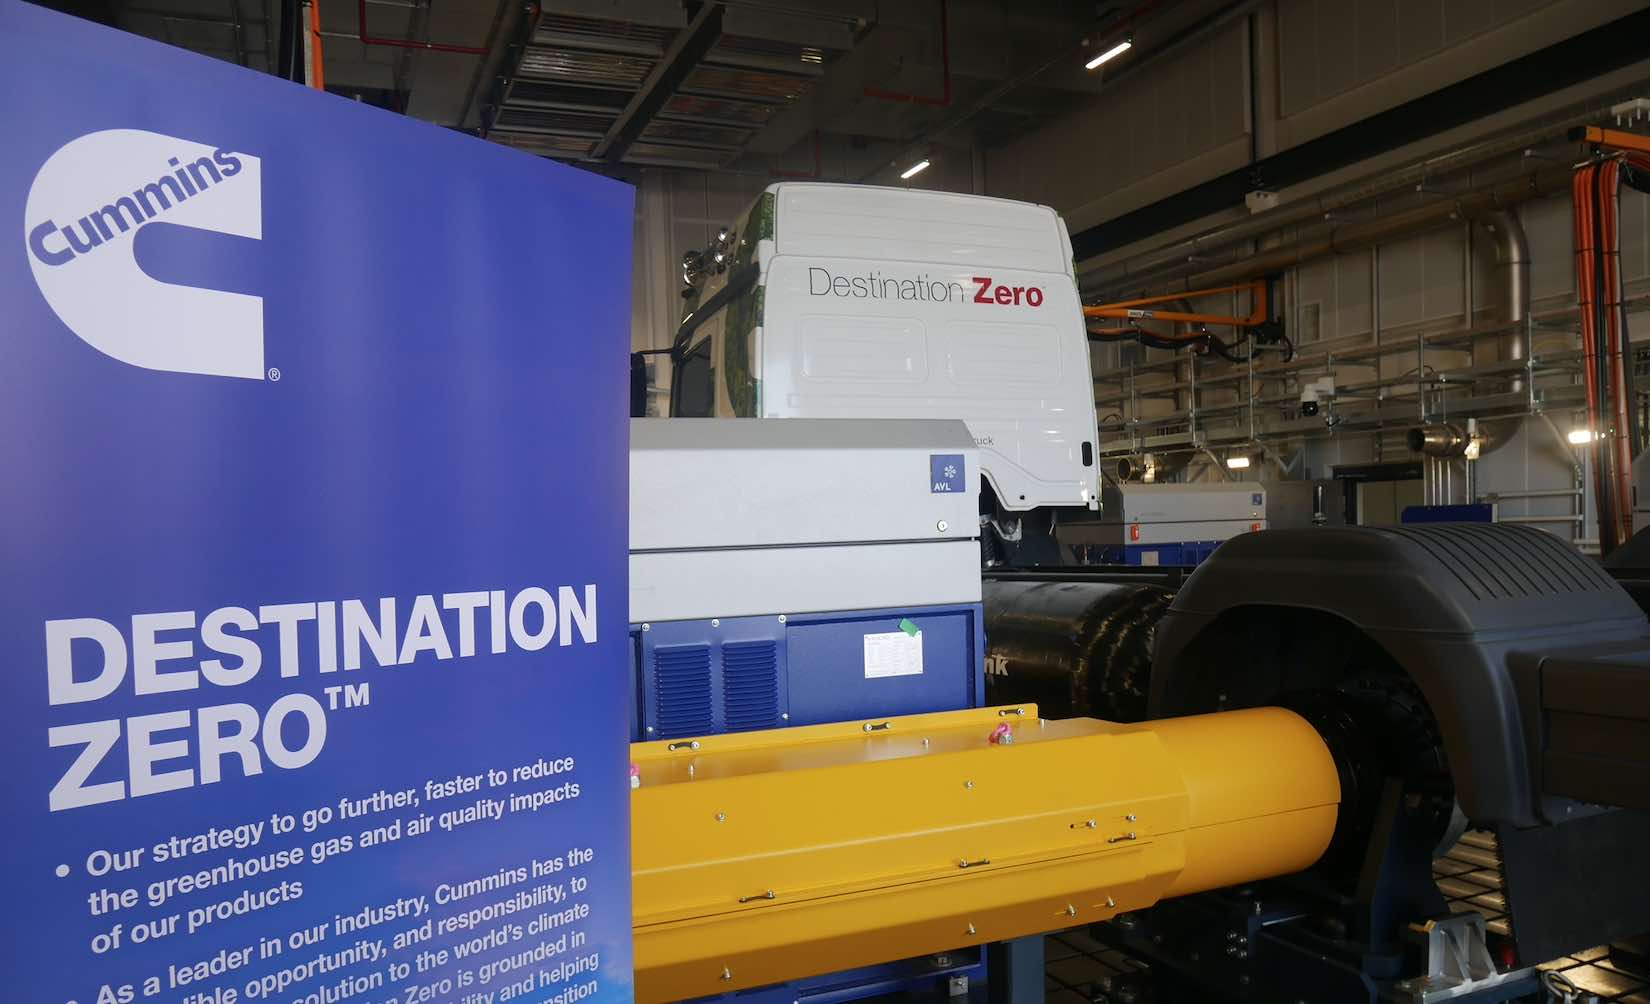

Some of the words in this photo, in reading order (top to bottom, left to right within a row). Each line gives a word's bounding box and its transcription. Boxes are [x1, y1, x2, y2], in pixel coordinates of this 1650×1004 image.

[29, 149, 242, 266] Cummins
[809, 267, 964, 302] Destination
[972, 277, 1044, 307] Zero
[934, 482, 952, 491] AVL
[45, 583, 598, 705] DESTINATION
[86, 848, 145, 876] Our
[153, 822, 264, 862] strategy
[270, 813, 296, 835] to
[302, 806, 333, 832] go
[338, 788, 419, 819] further,
[424, 774, 483, 800] faster
[488, 769, 508, 788] to
[513, 756, 574, 783] reduce
[88, 888, 139, 915] the
[147, 847, 304, 907] greenhouse
[310, 835, 353, 864] gas
[359, 819, 400, 848] and
[407, 814, 434, 836] air
[439, 799, 504, 831] quality
[510, 781, 580, 812] impacts
[91, 924, 122, 954] of
[130, 914, 180, 943] our
[188, 881, 303, 934] products
[96, 983, 135, 1004] As
[143, 976, 161, 997] a
[169, 945, 254, 989] leader
[260, 936, 282, 960] in
[288, 922, 329, 950] our
[335, 895, 429, 936] industry,
[434, 868, 528, 905] Cummins
[532, 856, 563, 879] has
[567, 848, 593, 867] the
[245, 939, 388, 999] opportunity,
[393, 919, 432, 950] and
[438, 884, 567, 935] responsibility,
[570, 877, 587, 894] to
[388, 962, 410, 982] to
[415, 950, 449, 973] the
[453, 924, 524, 960] world’s
[527, 903, 590, 936] climate
[404, 978, 452, 1004] Zero
[457, 969, 474, 989] is
[479, 934, 566, 985] grounded
[571, 931, 586, 949] in
[500, 974, 535, 1002] and
[539, 952, 600, 988] helping
